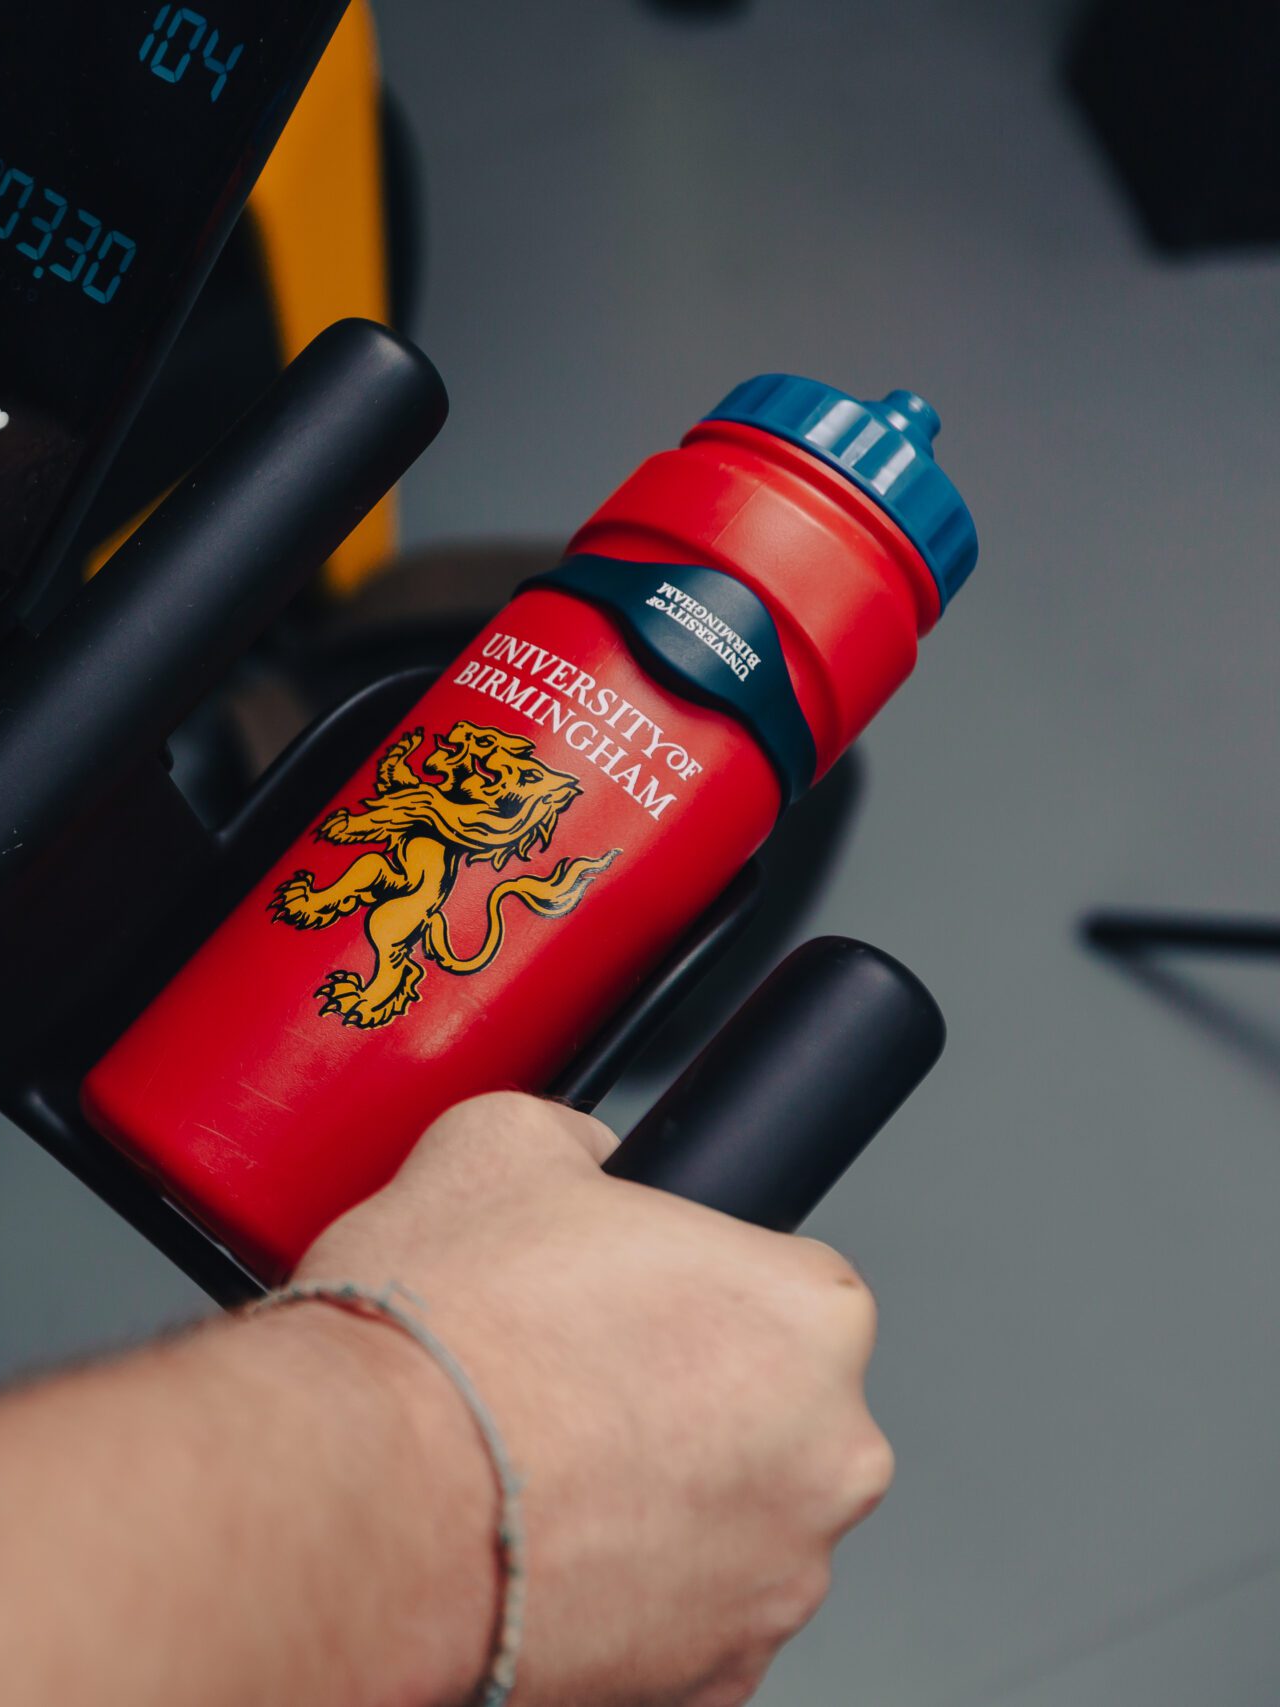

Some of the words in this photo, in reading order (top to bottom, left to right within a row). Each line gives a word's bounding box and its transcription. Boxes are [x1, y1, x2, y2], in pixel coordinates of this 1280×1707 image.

[138, 3, 244, 103] 104
[656, 581, 762, 671] BIRMINGHAM
[665, 602, 750, 682] UNIVERSITY
[453, 660, 678, 821] BIRMINGHAM
[481, 632, 670, 760] UNIVERSITY
